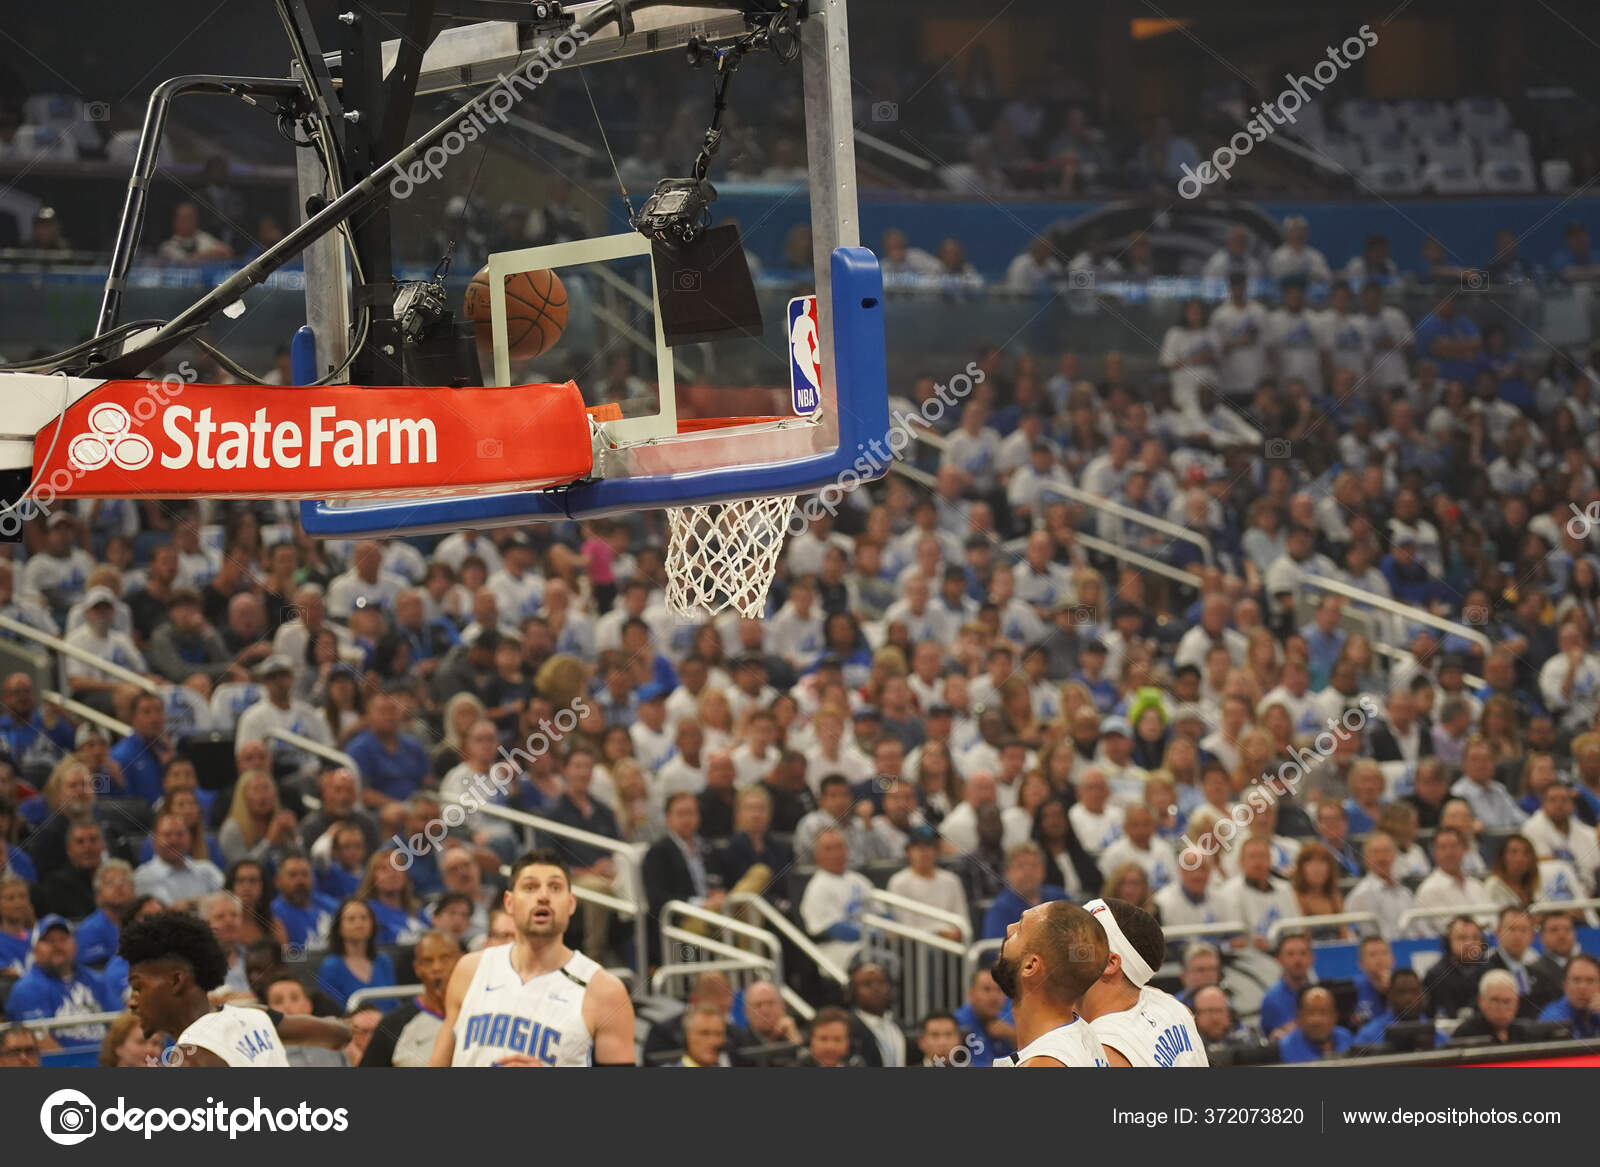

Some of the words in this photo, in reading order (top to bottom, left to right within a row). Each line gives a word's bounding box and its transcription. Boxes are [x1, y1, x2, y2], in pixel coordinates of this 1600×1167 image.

[797, 390, 815, 407] NBA
[235, 1029, 273, 1063] ISAAC
[463, 1013, 562, 1066] MAGIC
